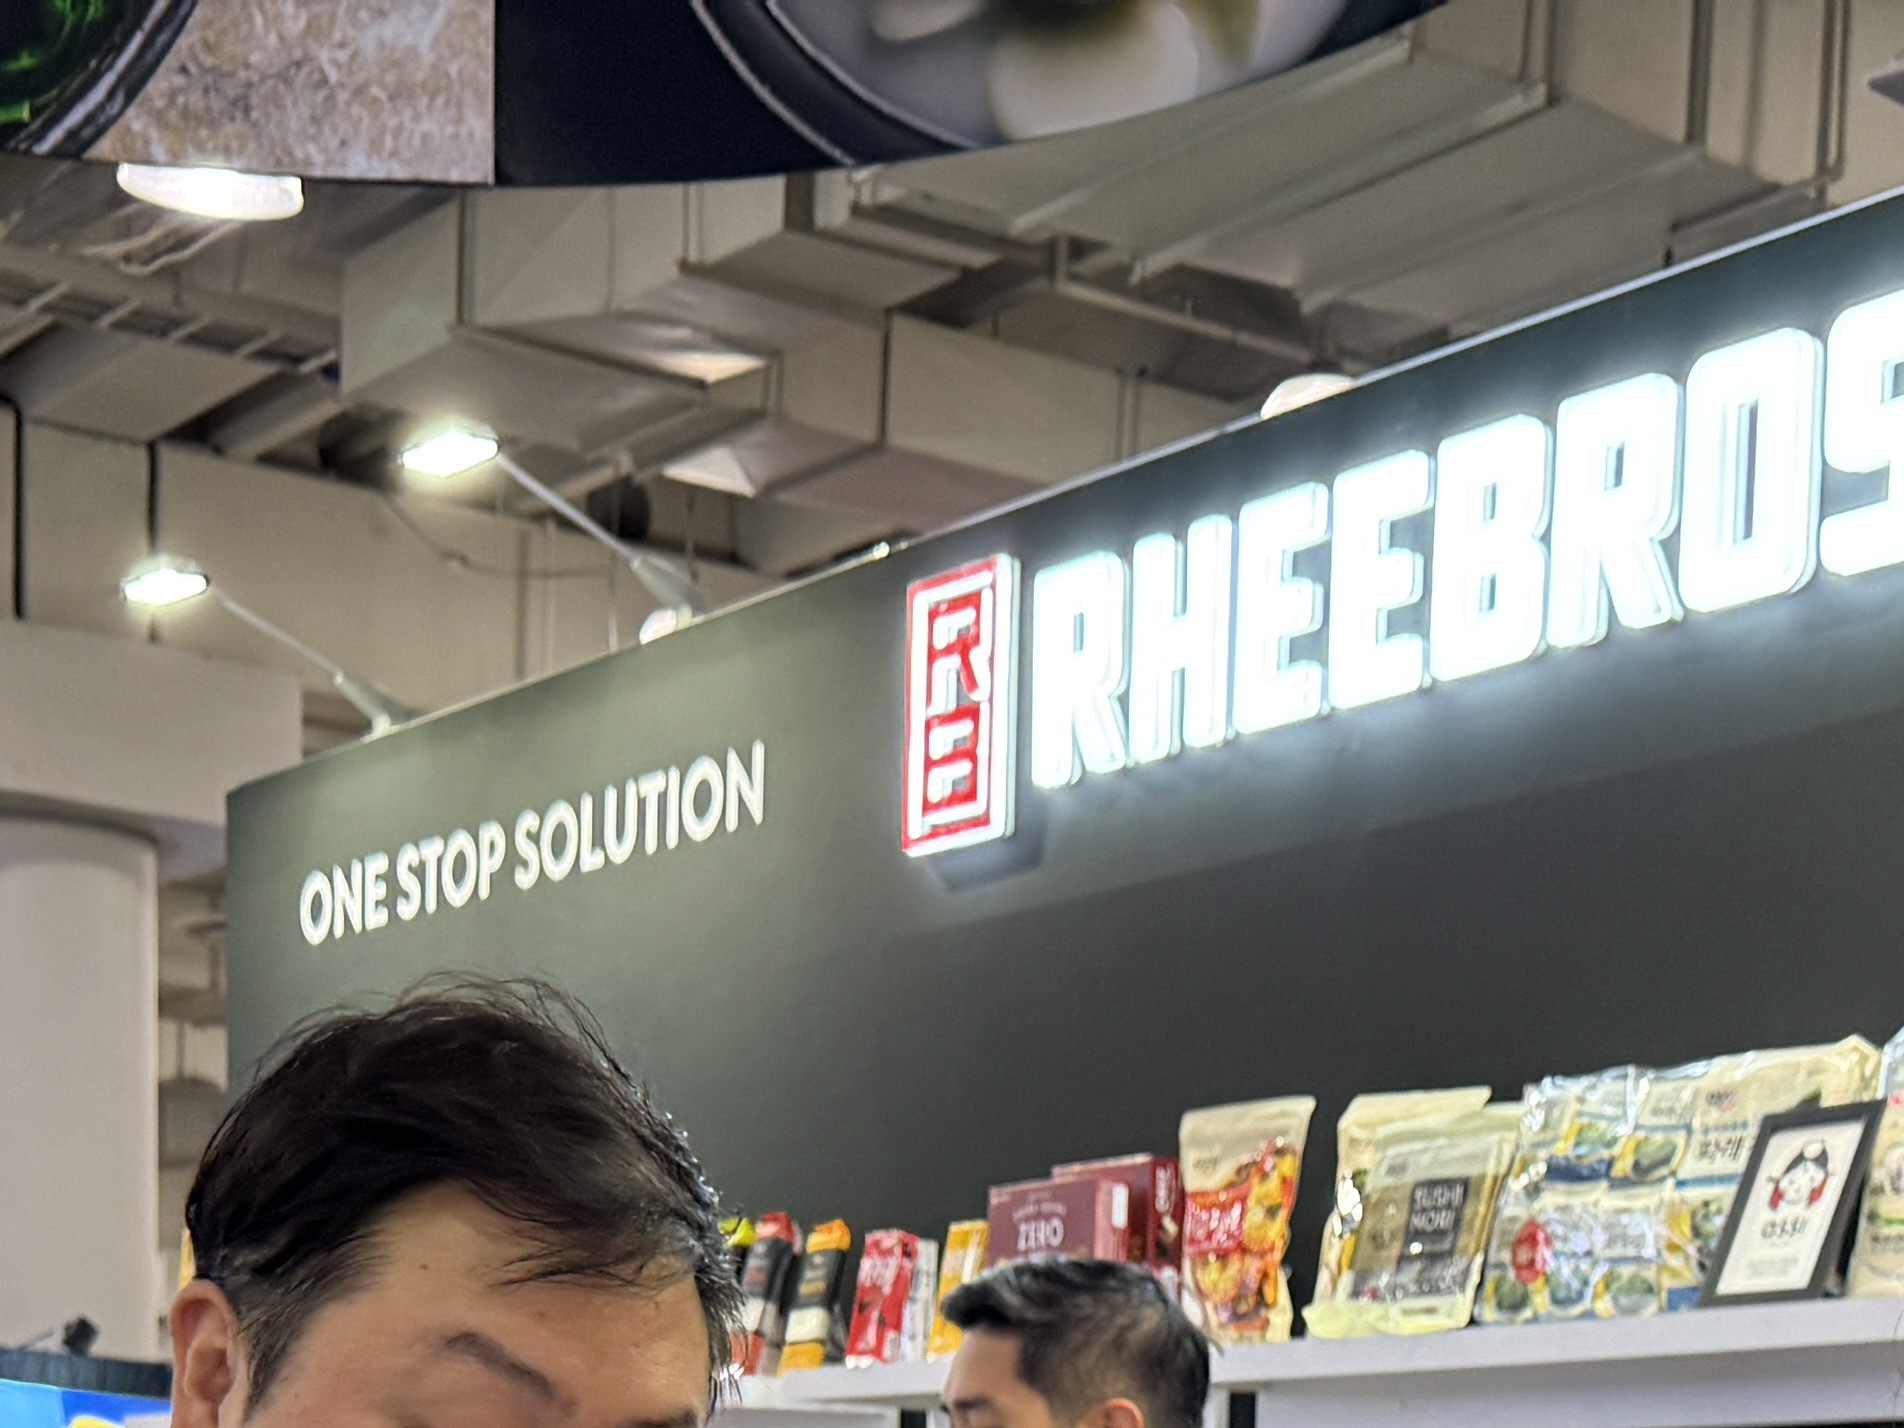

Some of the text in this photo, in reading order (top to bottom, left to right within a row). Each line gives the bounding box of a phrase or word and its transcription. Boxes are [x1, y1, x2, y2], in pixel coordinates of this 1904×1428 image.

[299, 737, 766, 946] ONE STOP SOLUTION
